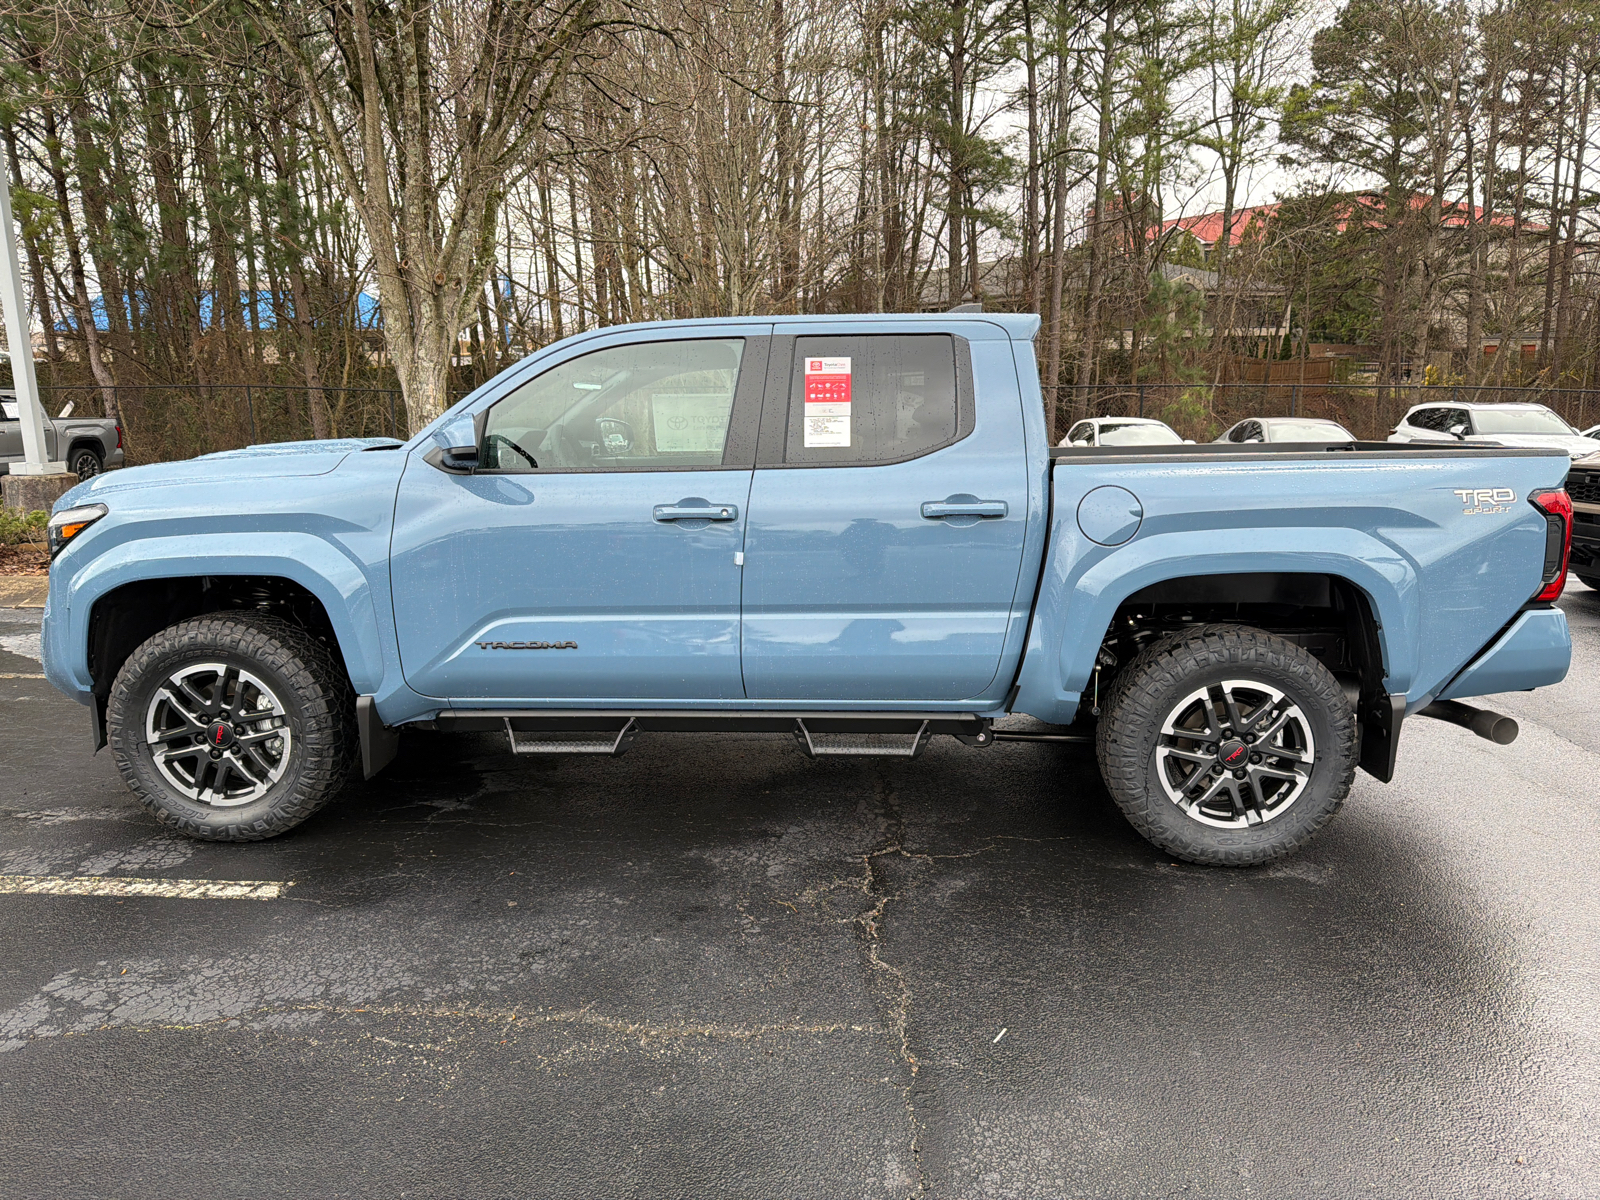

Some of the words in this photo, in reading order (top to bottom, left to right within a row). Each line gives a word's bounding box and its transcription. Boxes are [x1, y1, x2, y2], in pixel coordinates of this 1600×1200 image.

[1453, 488, 1517, 506] TRD
[1462, 506, 1511, 514] SPORT
[474, 641, 578, 649] TACOMA
[216, 725, 224, 744] TRD
[1225, 746, 1244, 762] TRD
